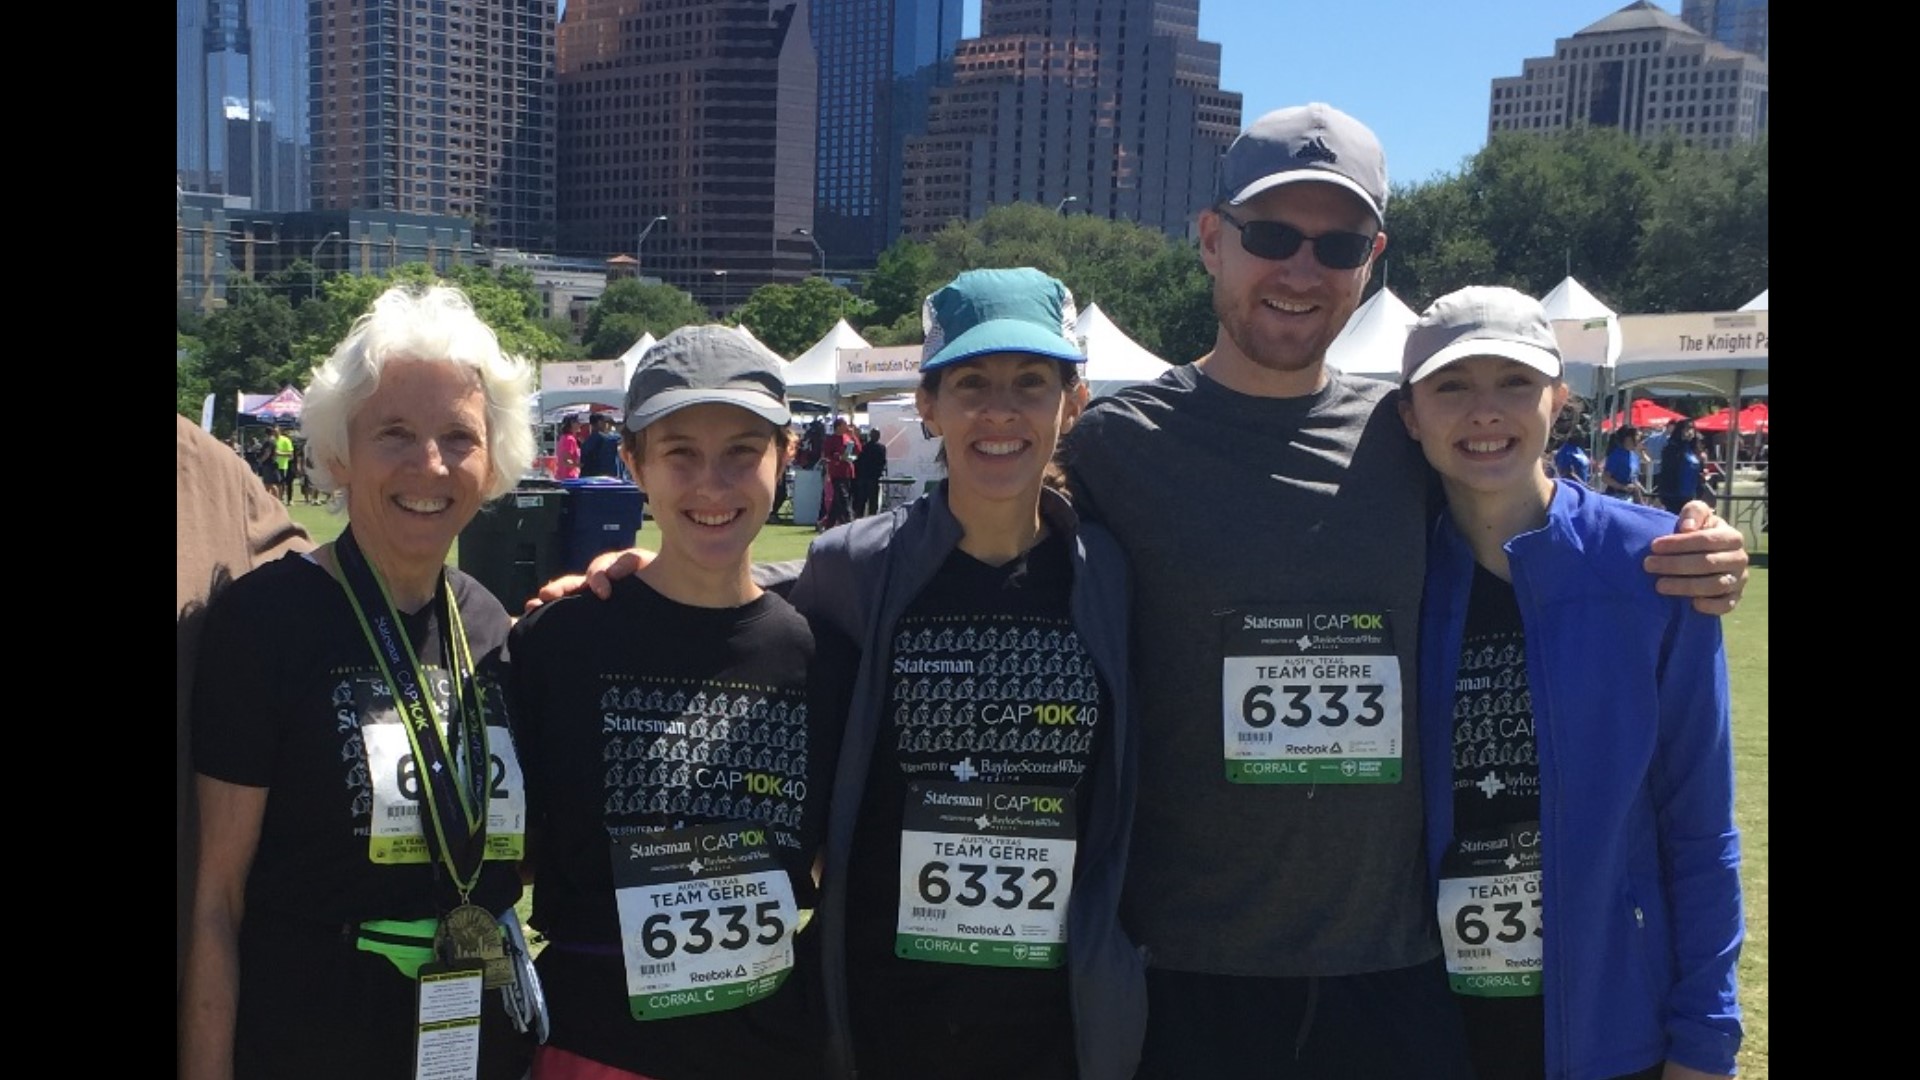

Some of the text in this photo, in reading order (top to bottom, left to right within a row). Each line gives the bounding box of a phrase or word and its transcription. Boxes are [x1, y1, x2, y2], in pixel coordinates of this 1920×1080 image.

[1679, 335, 1702, 351] The
[1707, 333, 1752, 352] Knight
[1242, 614, 1383, 630] Statesman CAP10K
[893, 656, 974, 674] Statesman
[1319, 657, 1344, 665] TEXAS
[1256, 665, 1372, 679] TEAM GERRE
[1242, 684, 1385, 729] 6333
[603, 713, 687, 736] Statesman
[1285, 743, 1328, 755] Reebok
[1243, 761, 1309, 775] CORRAL C
[397, 753, 509, 801] 62
[922, 790, 1064, 814] Statesman CAP10K
[630, 830, 768, 860] Statesman CAP10K
[934, 842, 1049, 862] TEAM GERRE
[712, 877, 739, 887] TEXAS
[918, 860, 1058, 911] 6332
[650, 881, 769, 908] TEAM GERRE
[1468, 883, 1518, 900] TEAM
[641, 899, 785, 960] 6335
[957, 923, 1002, 937] Reebok
[915, 938, 966, 953] CORRAL
[969, 942, 980, 955] C
[1505, 956, 1542, 969] Reebo
[690, 967, 734, 984] Reebok
[1466, 975, 1532, 989] CORRAL C
[650, 990, 702, 1008] CORRAL
[705, 988, 716, 1002] C
